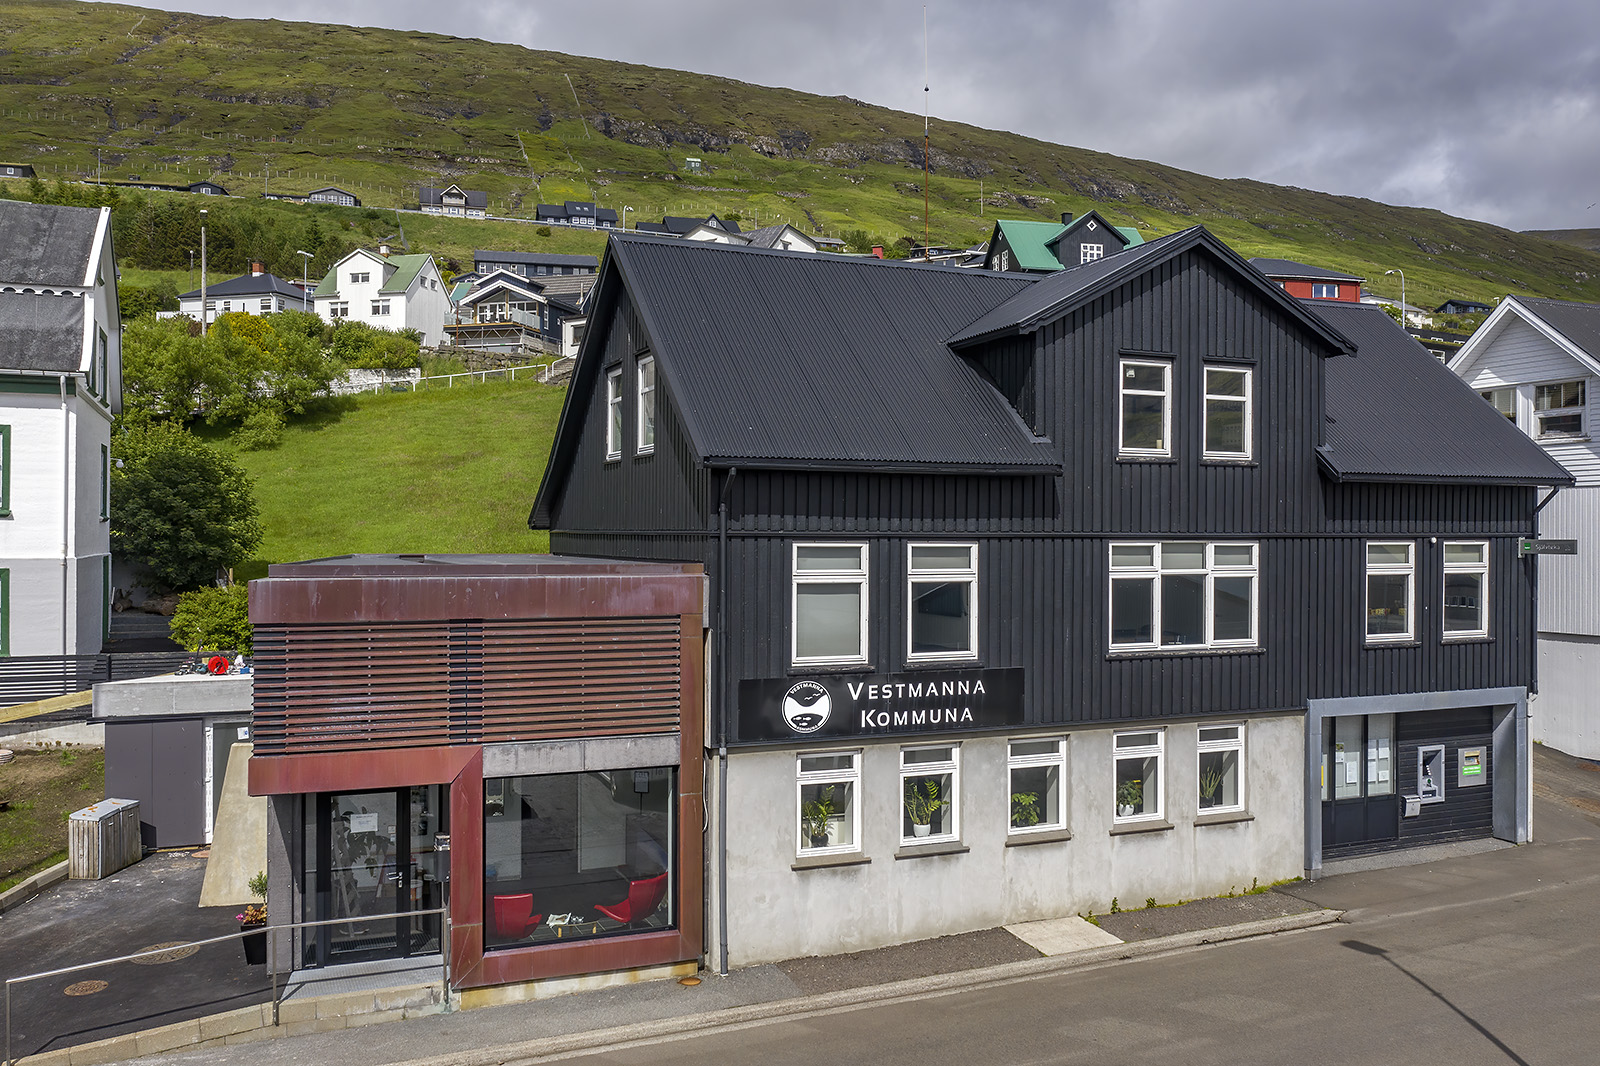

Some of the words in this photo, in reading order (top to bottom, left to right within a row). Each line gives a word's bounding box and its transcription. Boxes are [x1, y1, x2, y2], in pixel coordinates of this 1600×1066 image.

[790, 683, 824, 694] VESTMANNA
[847, 680, 986, 701] VESTMANNA
[861, 707, 974, 728] KOMMUNA
